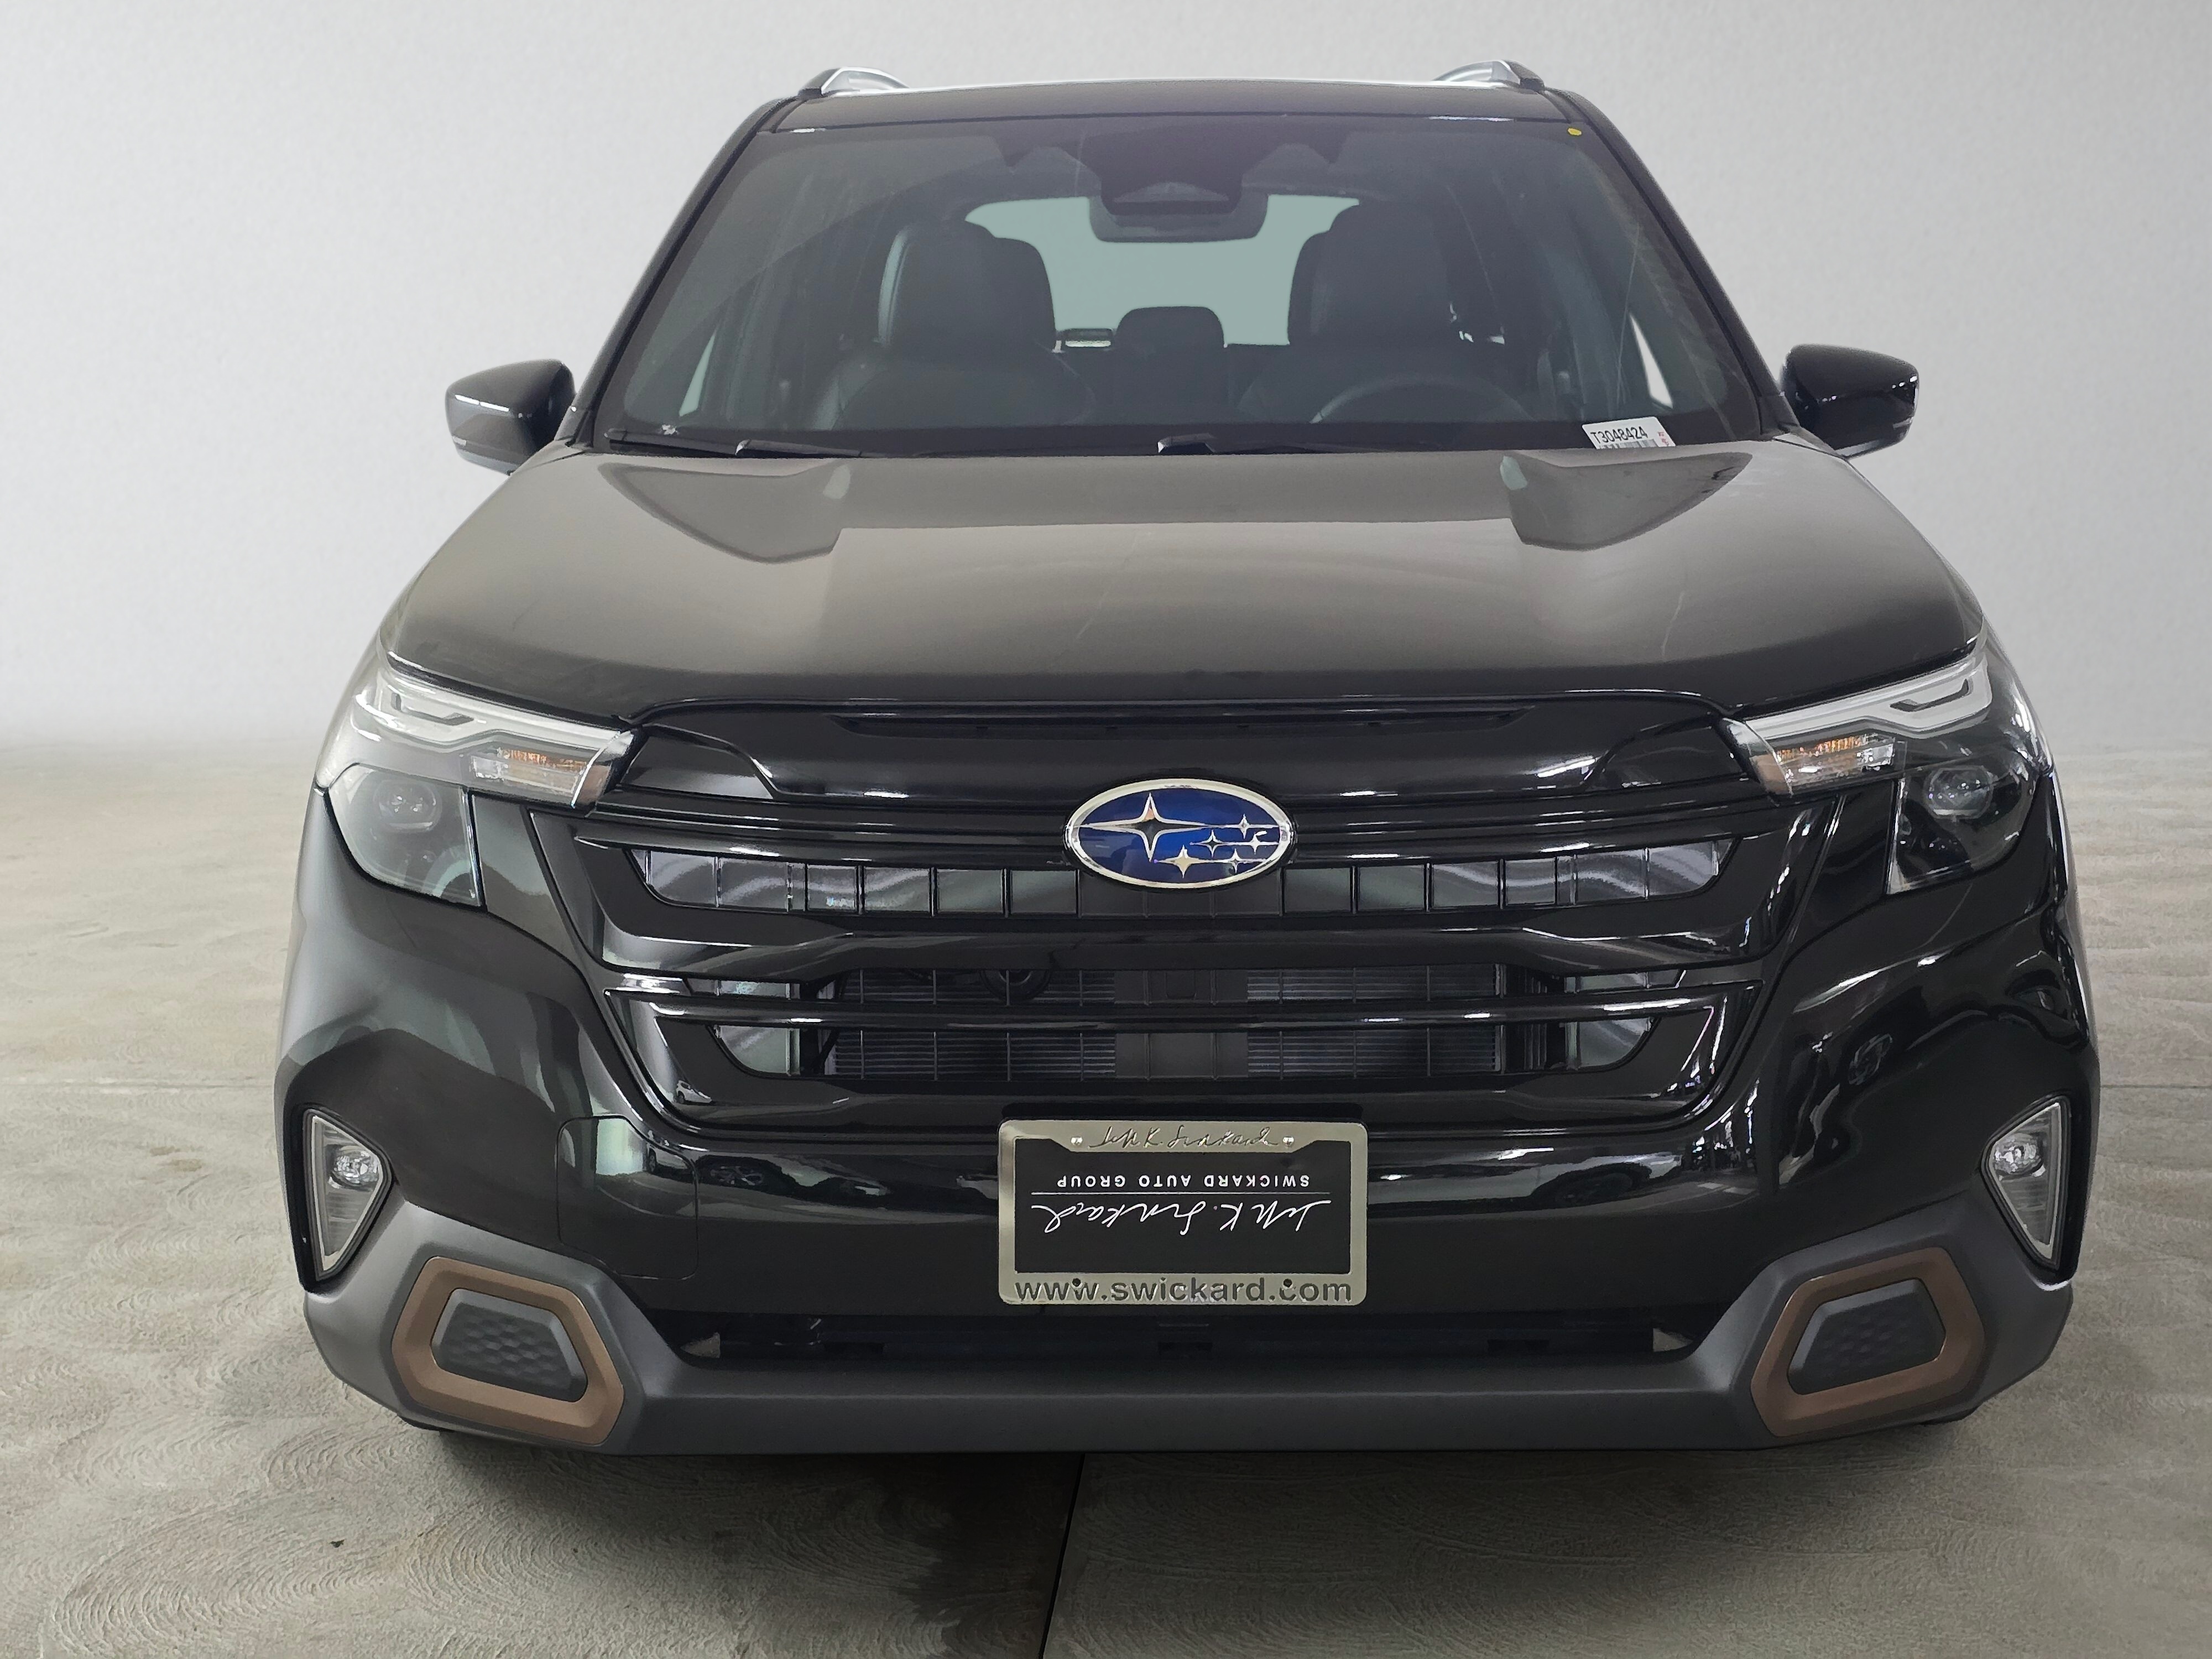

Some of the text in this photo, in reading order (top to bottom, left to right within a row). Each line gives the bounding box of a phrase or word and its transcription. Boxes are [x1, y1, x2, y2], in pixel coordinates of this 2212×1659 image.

[1590, 426, 1648, 444] T3048424
[1057, 1175, 1310, 1188] SWICKARD AUTO GROUP
[1014, 1277, 1353, 1302] www.swickard.com
